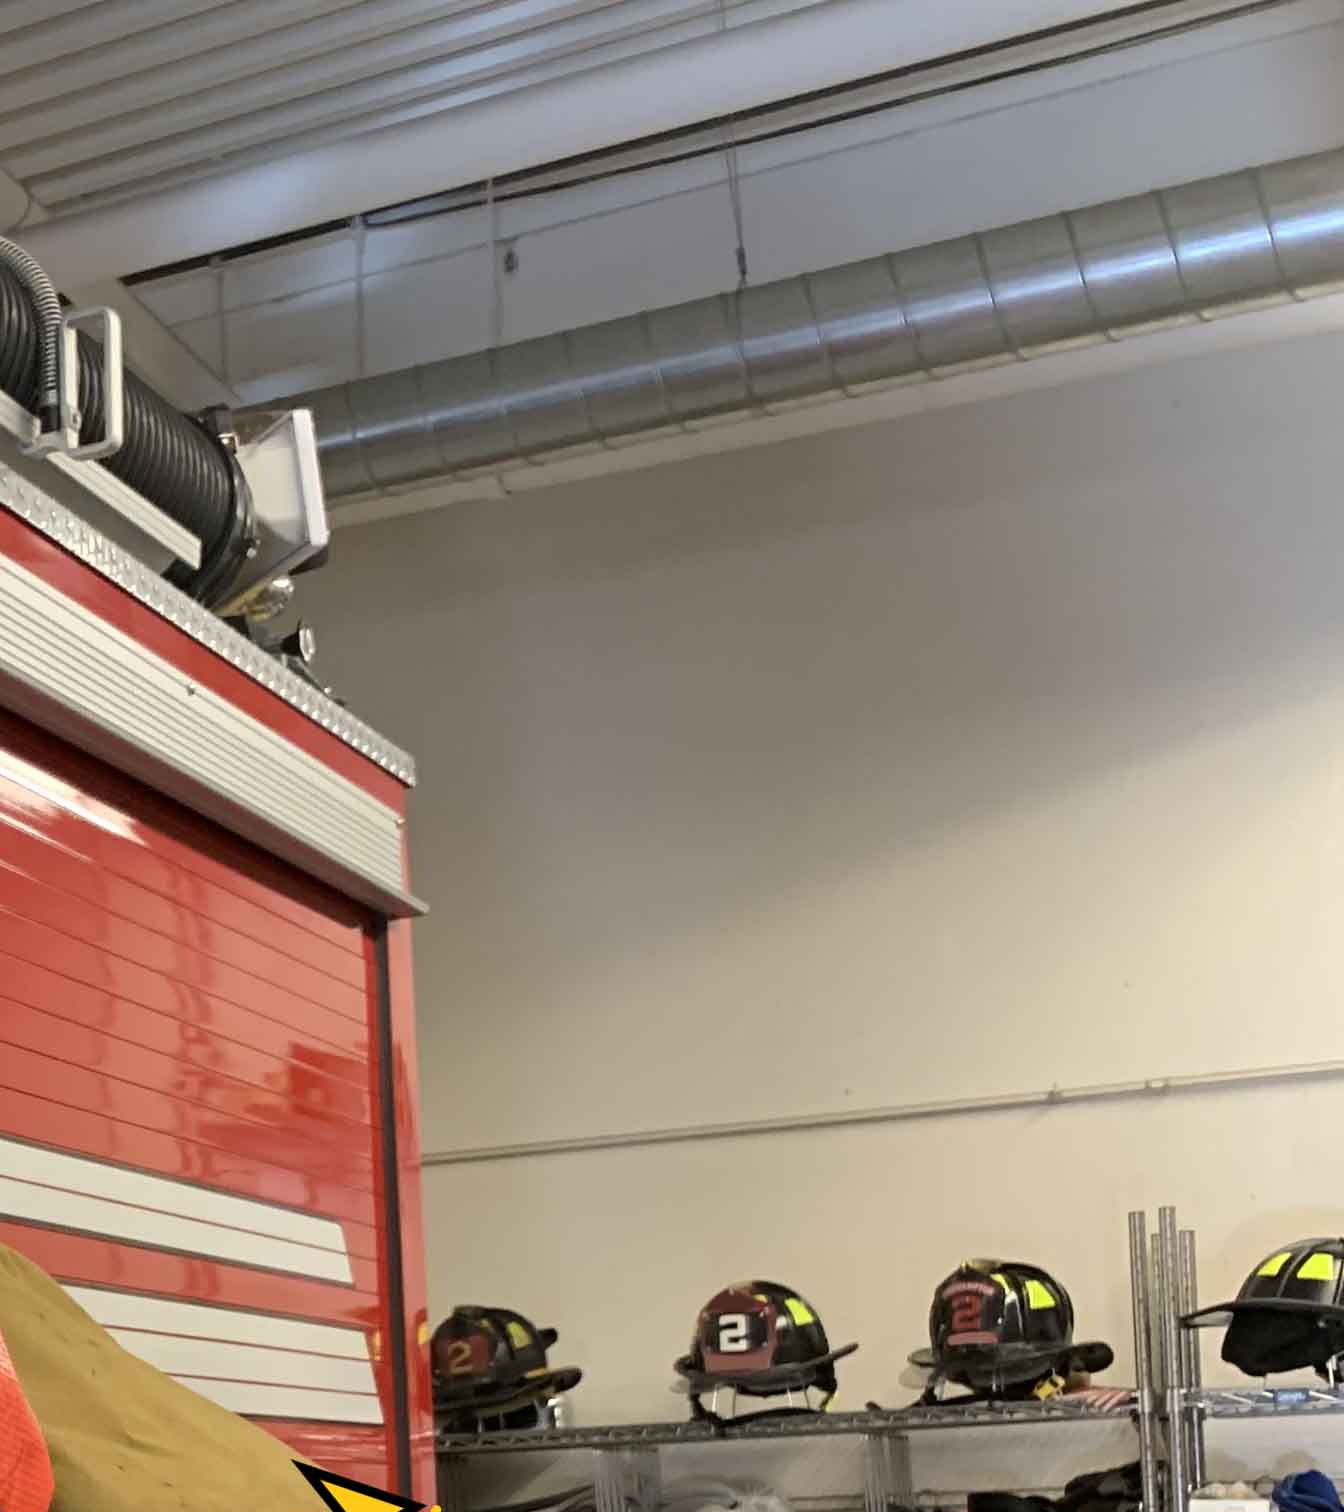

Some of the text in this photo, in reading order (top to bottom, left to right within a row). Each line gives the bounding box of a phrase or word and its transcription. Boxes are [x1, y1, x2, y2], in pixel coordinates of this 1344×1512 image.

[947, 1294, 983, 1330] 2
[718, 1313, 749, 1353] 2
[447, 1340, 473, 1375] 2
